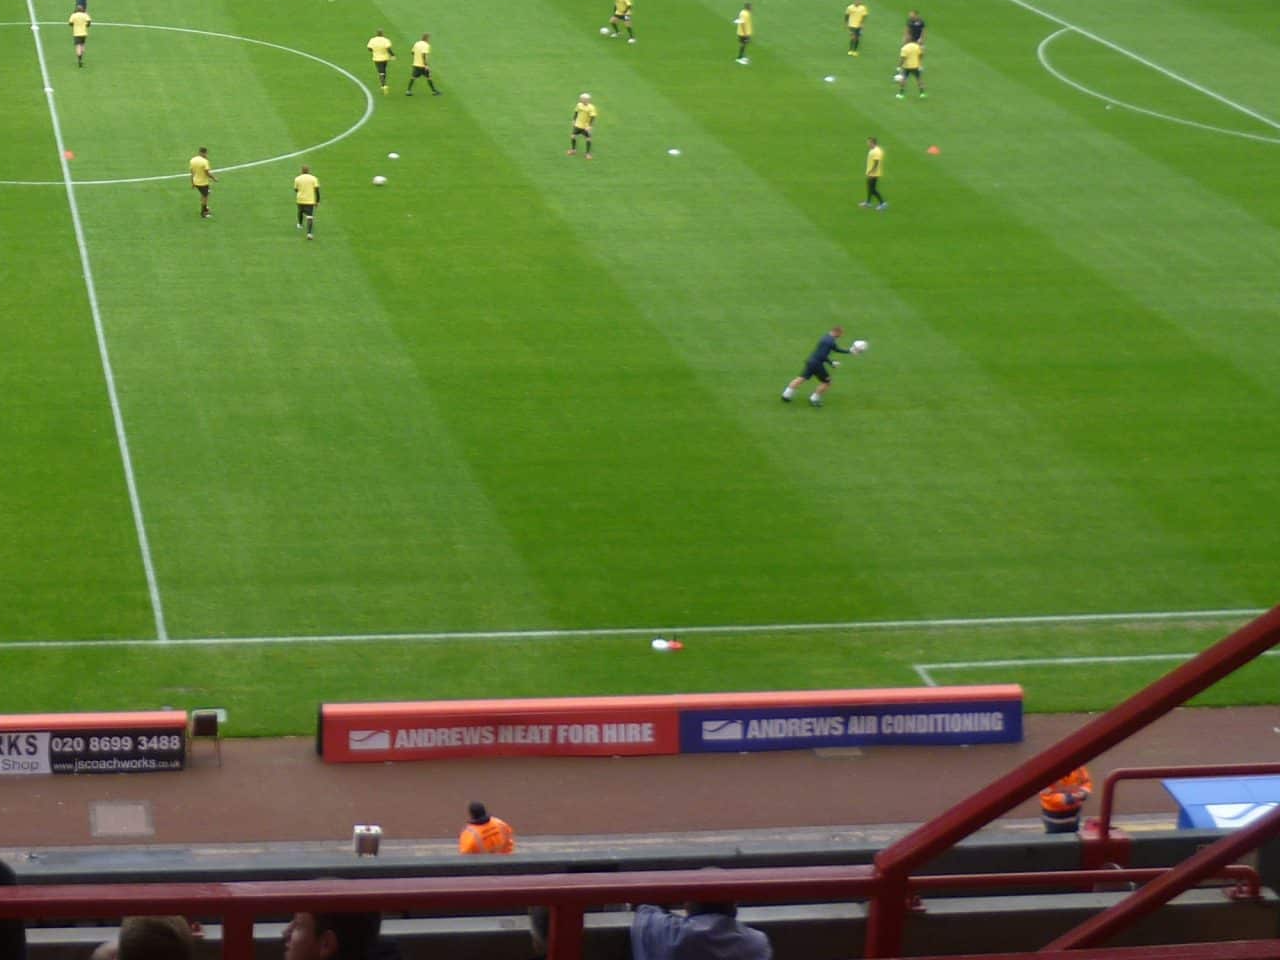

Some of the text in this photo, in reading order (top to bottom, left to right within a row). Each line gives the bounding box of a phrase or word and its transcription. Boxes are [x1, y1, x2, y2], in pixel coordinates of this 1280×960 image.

[747, 711, 1004, 738] ANDREWS AIR CONDITIONING
[52, 735, 181, 751] 020 8699 3488
[393, 722, 655, 749] ANDREWS HEAT FOR HIRE
[1, 758, 39, 774] Shop
